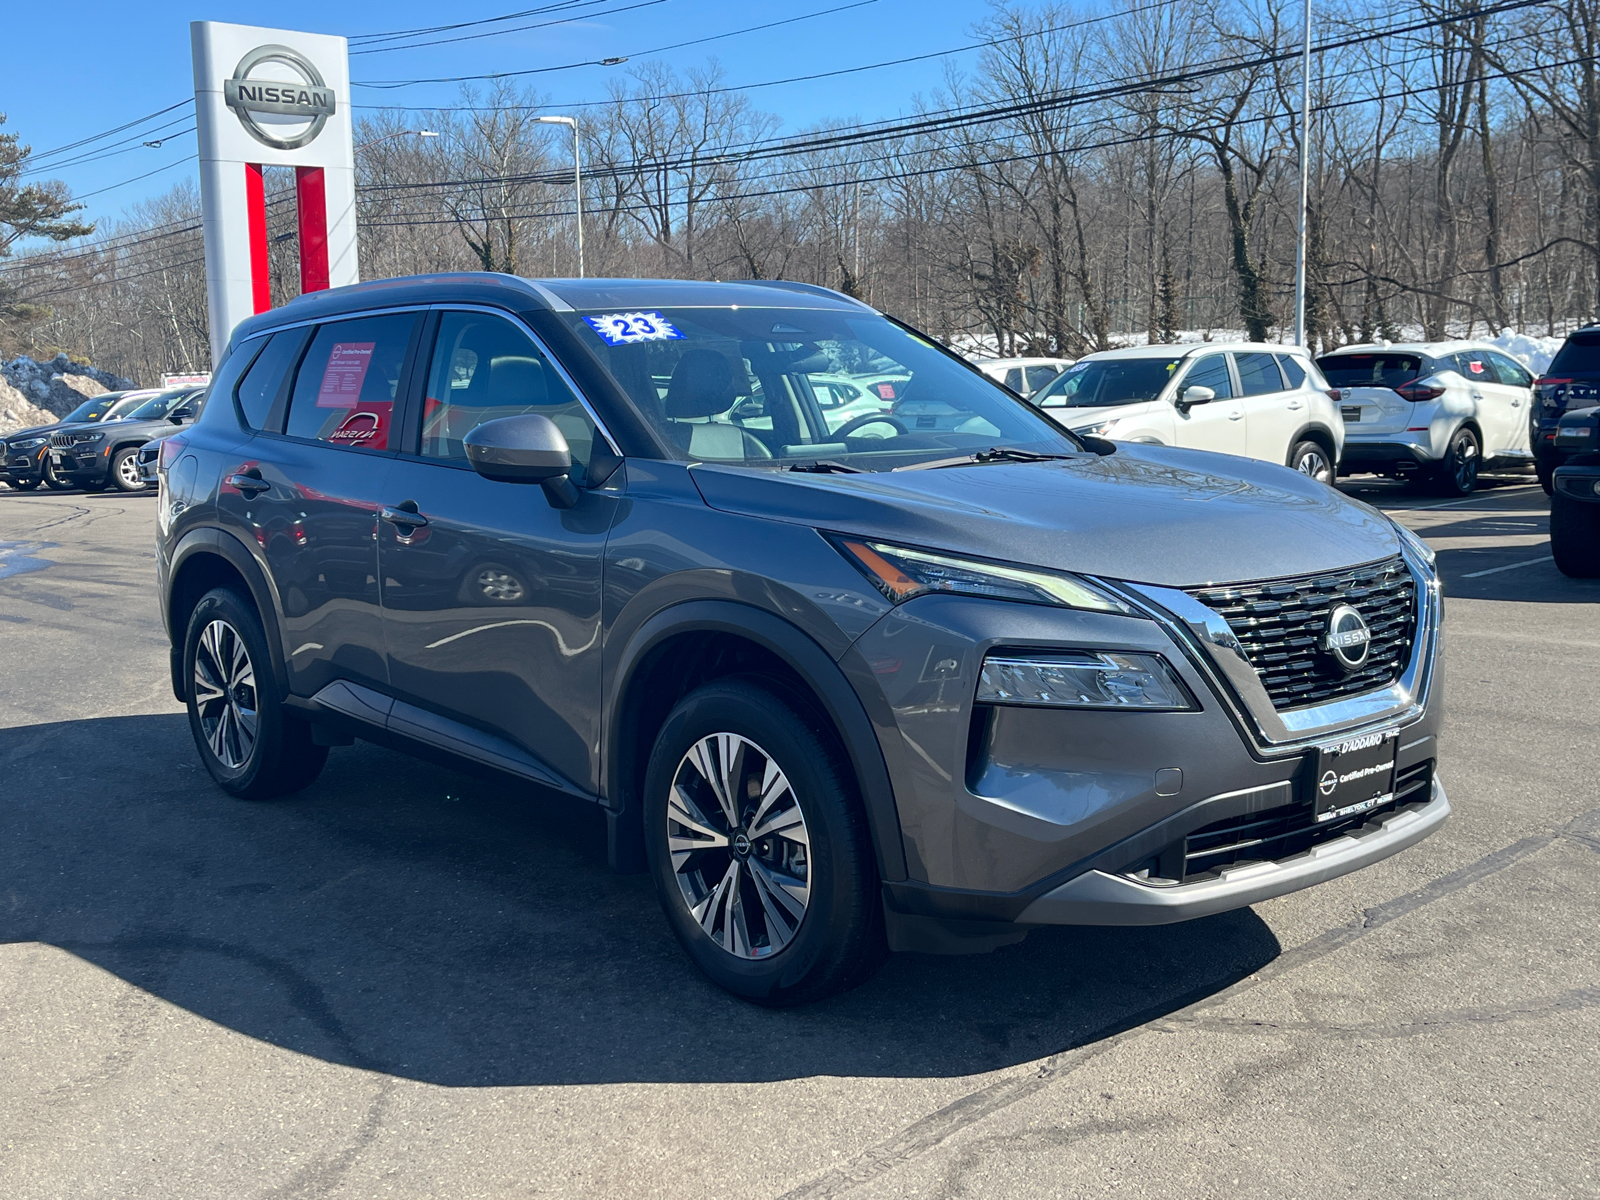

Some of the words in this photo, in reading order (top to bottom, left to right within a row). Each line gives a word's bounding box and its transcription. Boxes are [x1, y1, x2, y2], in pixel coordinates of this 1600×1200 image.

[238, 85, 327, 108] NISSAN
[612, 317, 656, 336] 23
[1329, 628, 1371, 646] NISSAN
[1341, 733, 1383, 754] D'ADDARIO
[1340, 769, 1364, 783] Certified
[1364, 760, 1394, 776] Pre-Owned
